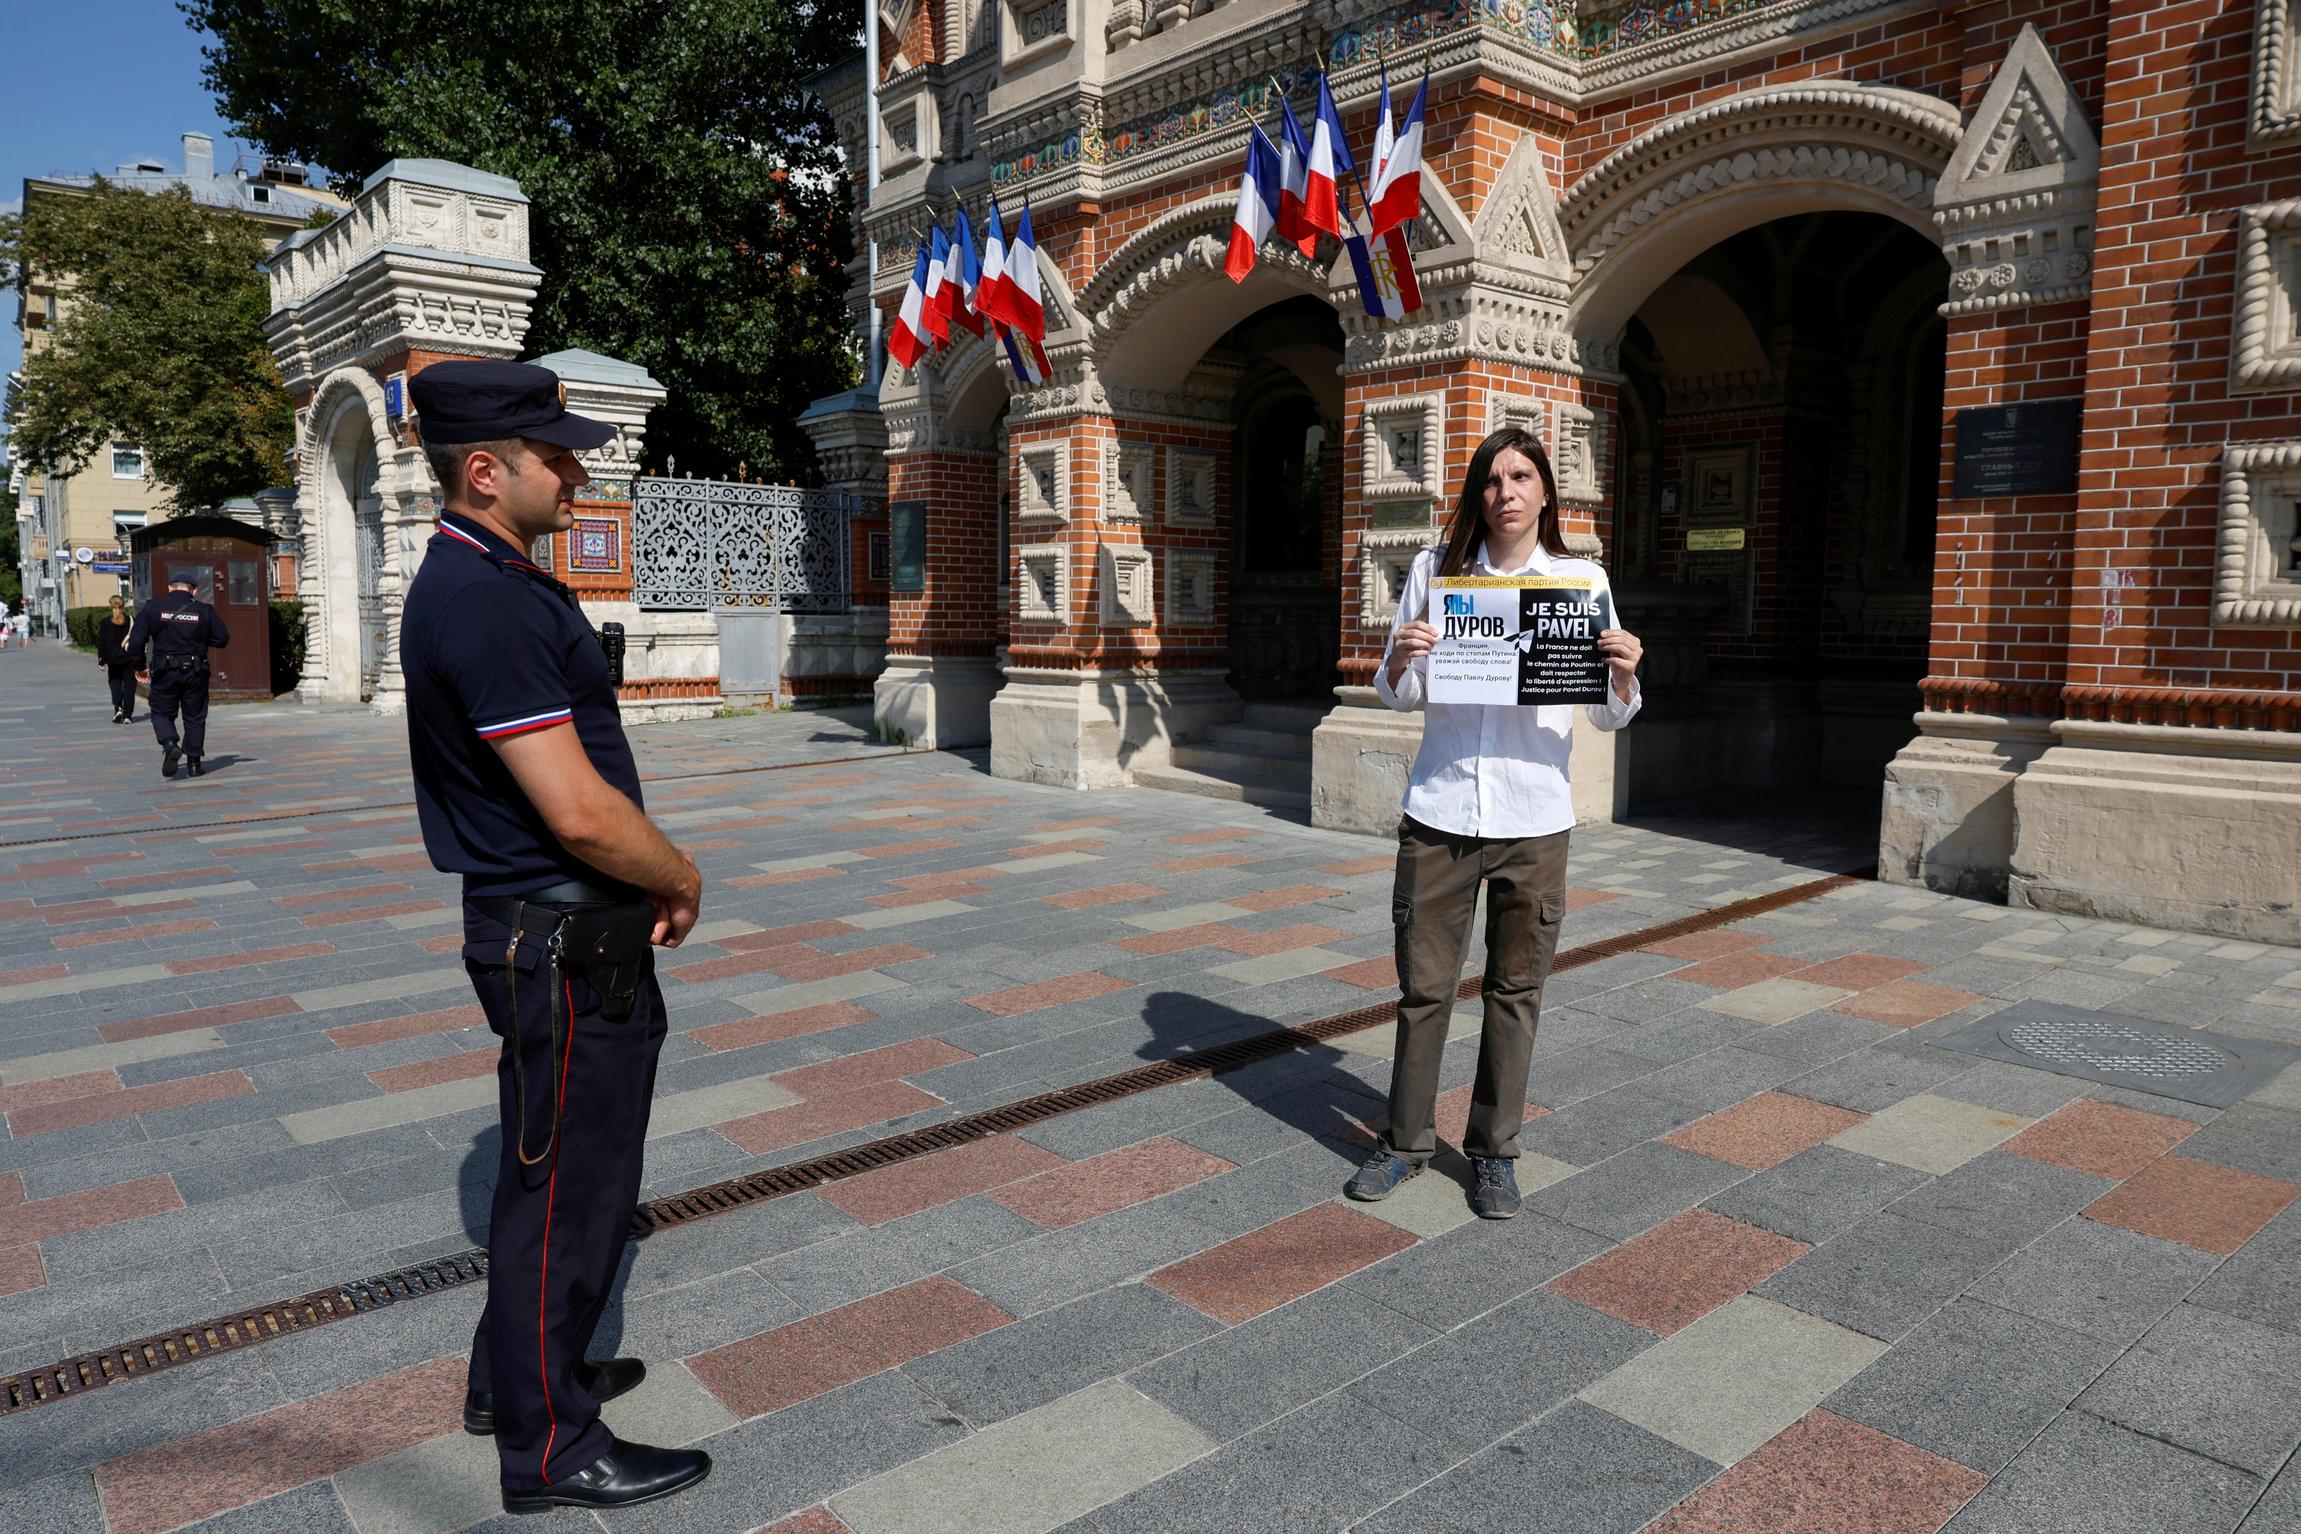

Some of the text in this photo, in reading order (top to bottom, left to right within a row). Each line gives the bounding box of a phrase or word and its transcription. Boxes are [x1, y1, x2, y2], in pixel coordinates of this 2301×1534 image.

[1446, 577, 1525, 588] Либертарианская
[1528, 578, 1559, 588] партия
[1526, 602, 1601, 616] JE SUIS
[1443, 616, 1505, 639] ДУРОВ
[1537, 618, 1594, 640] PAVEL
